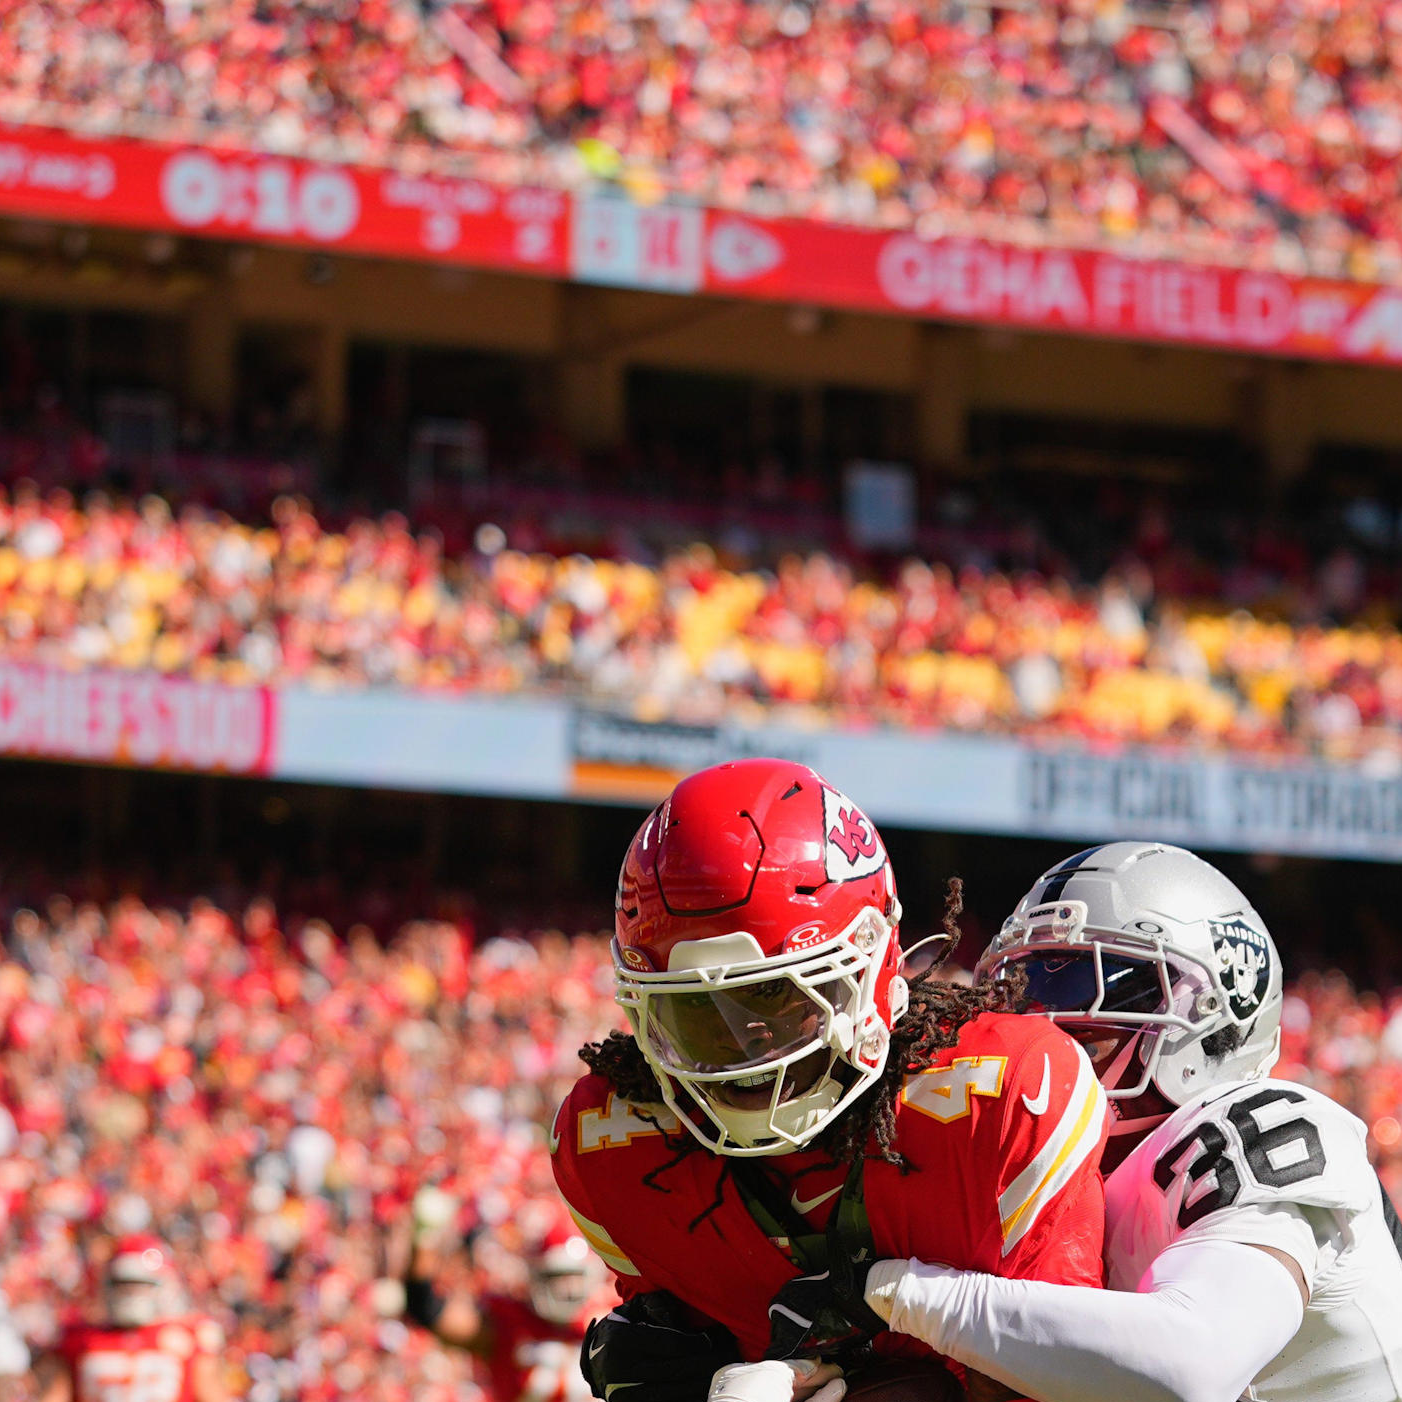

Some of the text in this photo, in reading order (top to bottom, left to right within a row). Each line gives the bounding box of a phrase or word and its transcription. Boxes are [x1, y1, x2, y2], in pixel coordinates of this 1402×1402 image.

[160, 150, 362, 242] 0:10
[1215, 922, 1267, 949] RAIDERS
[901, 1055, 1008, 1124] 4
[1152, 1087, 1326, 1231] 36
